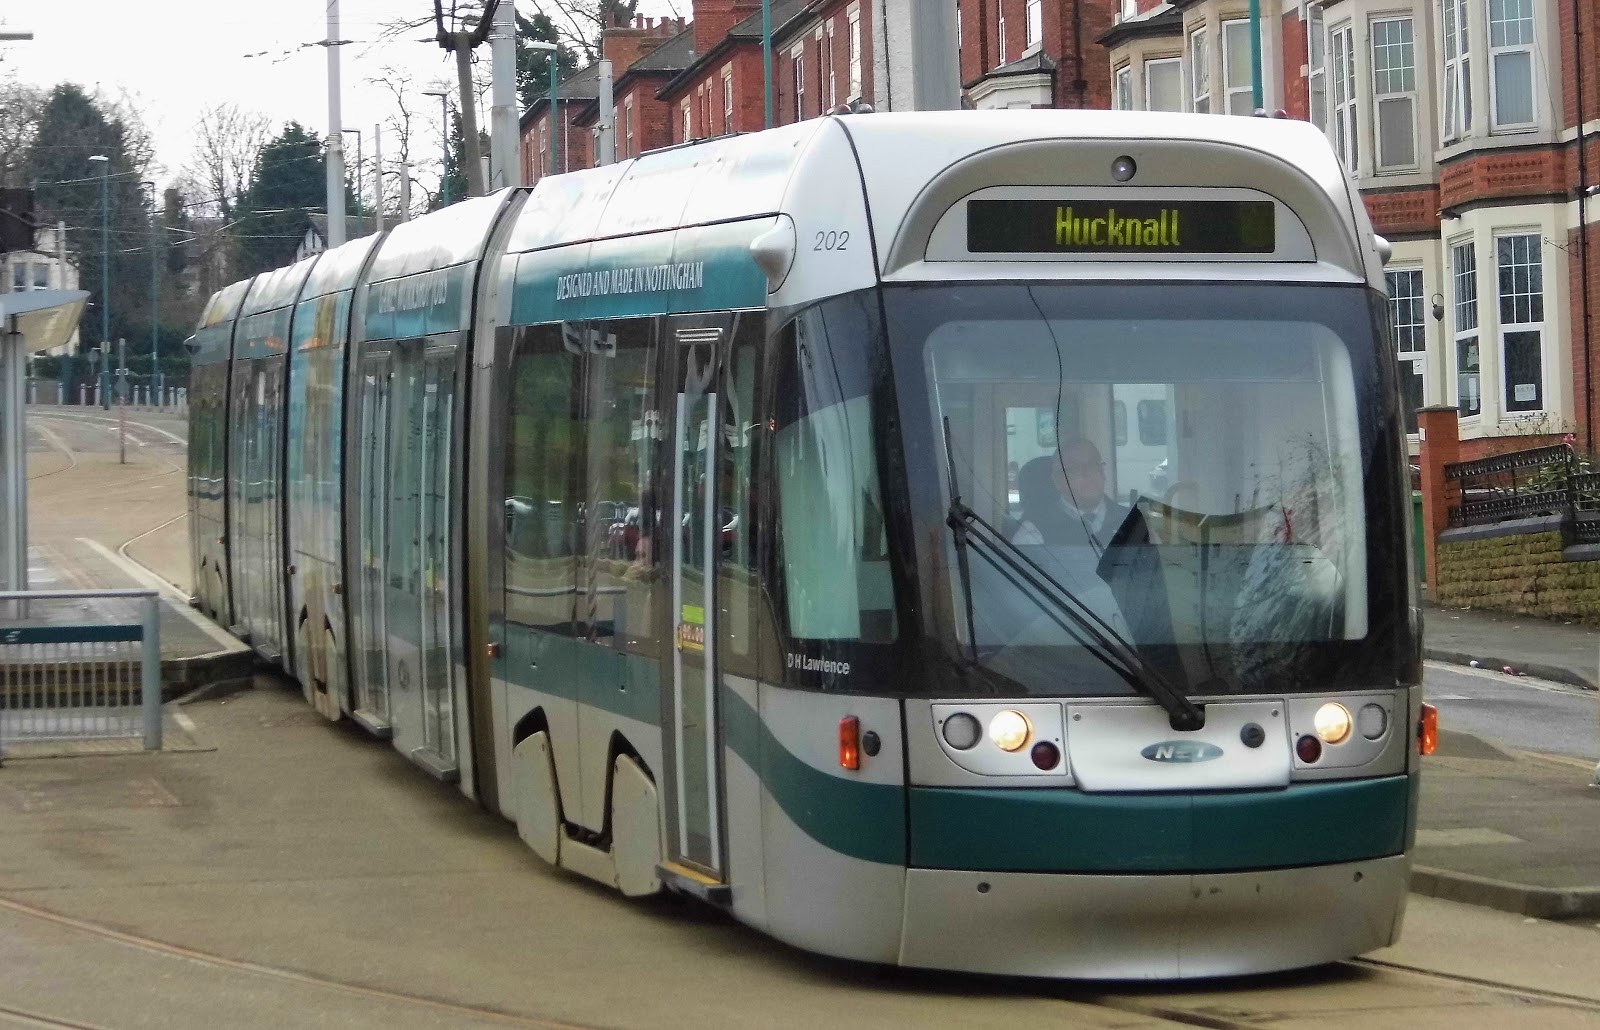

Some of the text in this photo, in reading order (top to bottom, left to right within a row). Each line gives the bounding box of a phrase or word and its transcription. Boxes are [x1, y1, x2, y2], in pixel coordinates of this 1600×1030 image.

[813, 230, 850, 251] 202
[1055, 206, 1181, 246] Hucknall
[556, 261, 704, 301] DESIGNED AND MADE IN NOTTINGHAM
[787, 652, 850, 675] D H Lawrence
